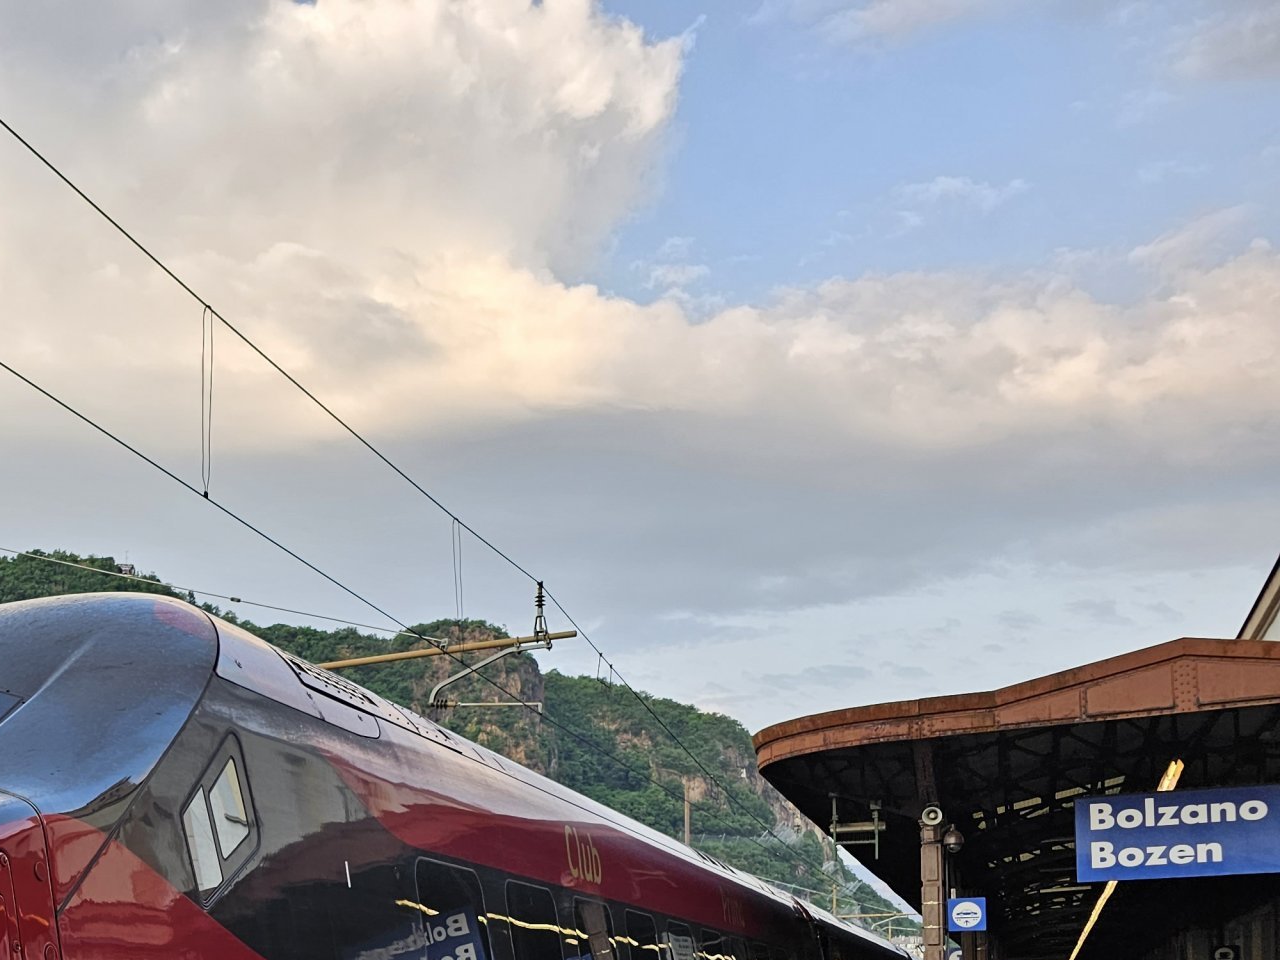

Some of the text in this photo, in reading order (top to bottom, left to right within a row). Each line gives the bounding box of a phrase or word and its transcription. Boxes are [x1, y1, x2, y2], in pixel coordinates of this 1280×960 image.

[1089, 797, 1269, 831] Bolzano
[564, 824, 602, 884] Club
[1090, 840, 1223, 869] Bozen
